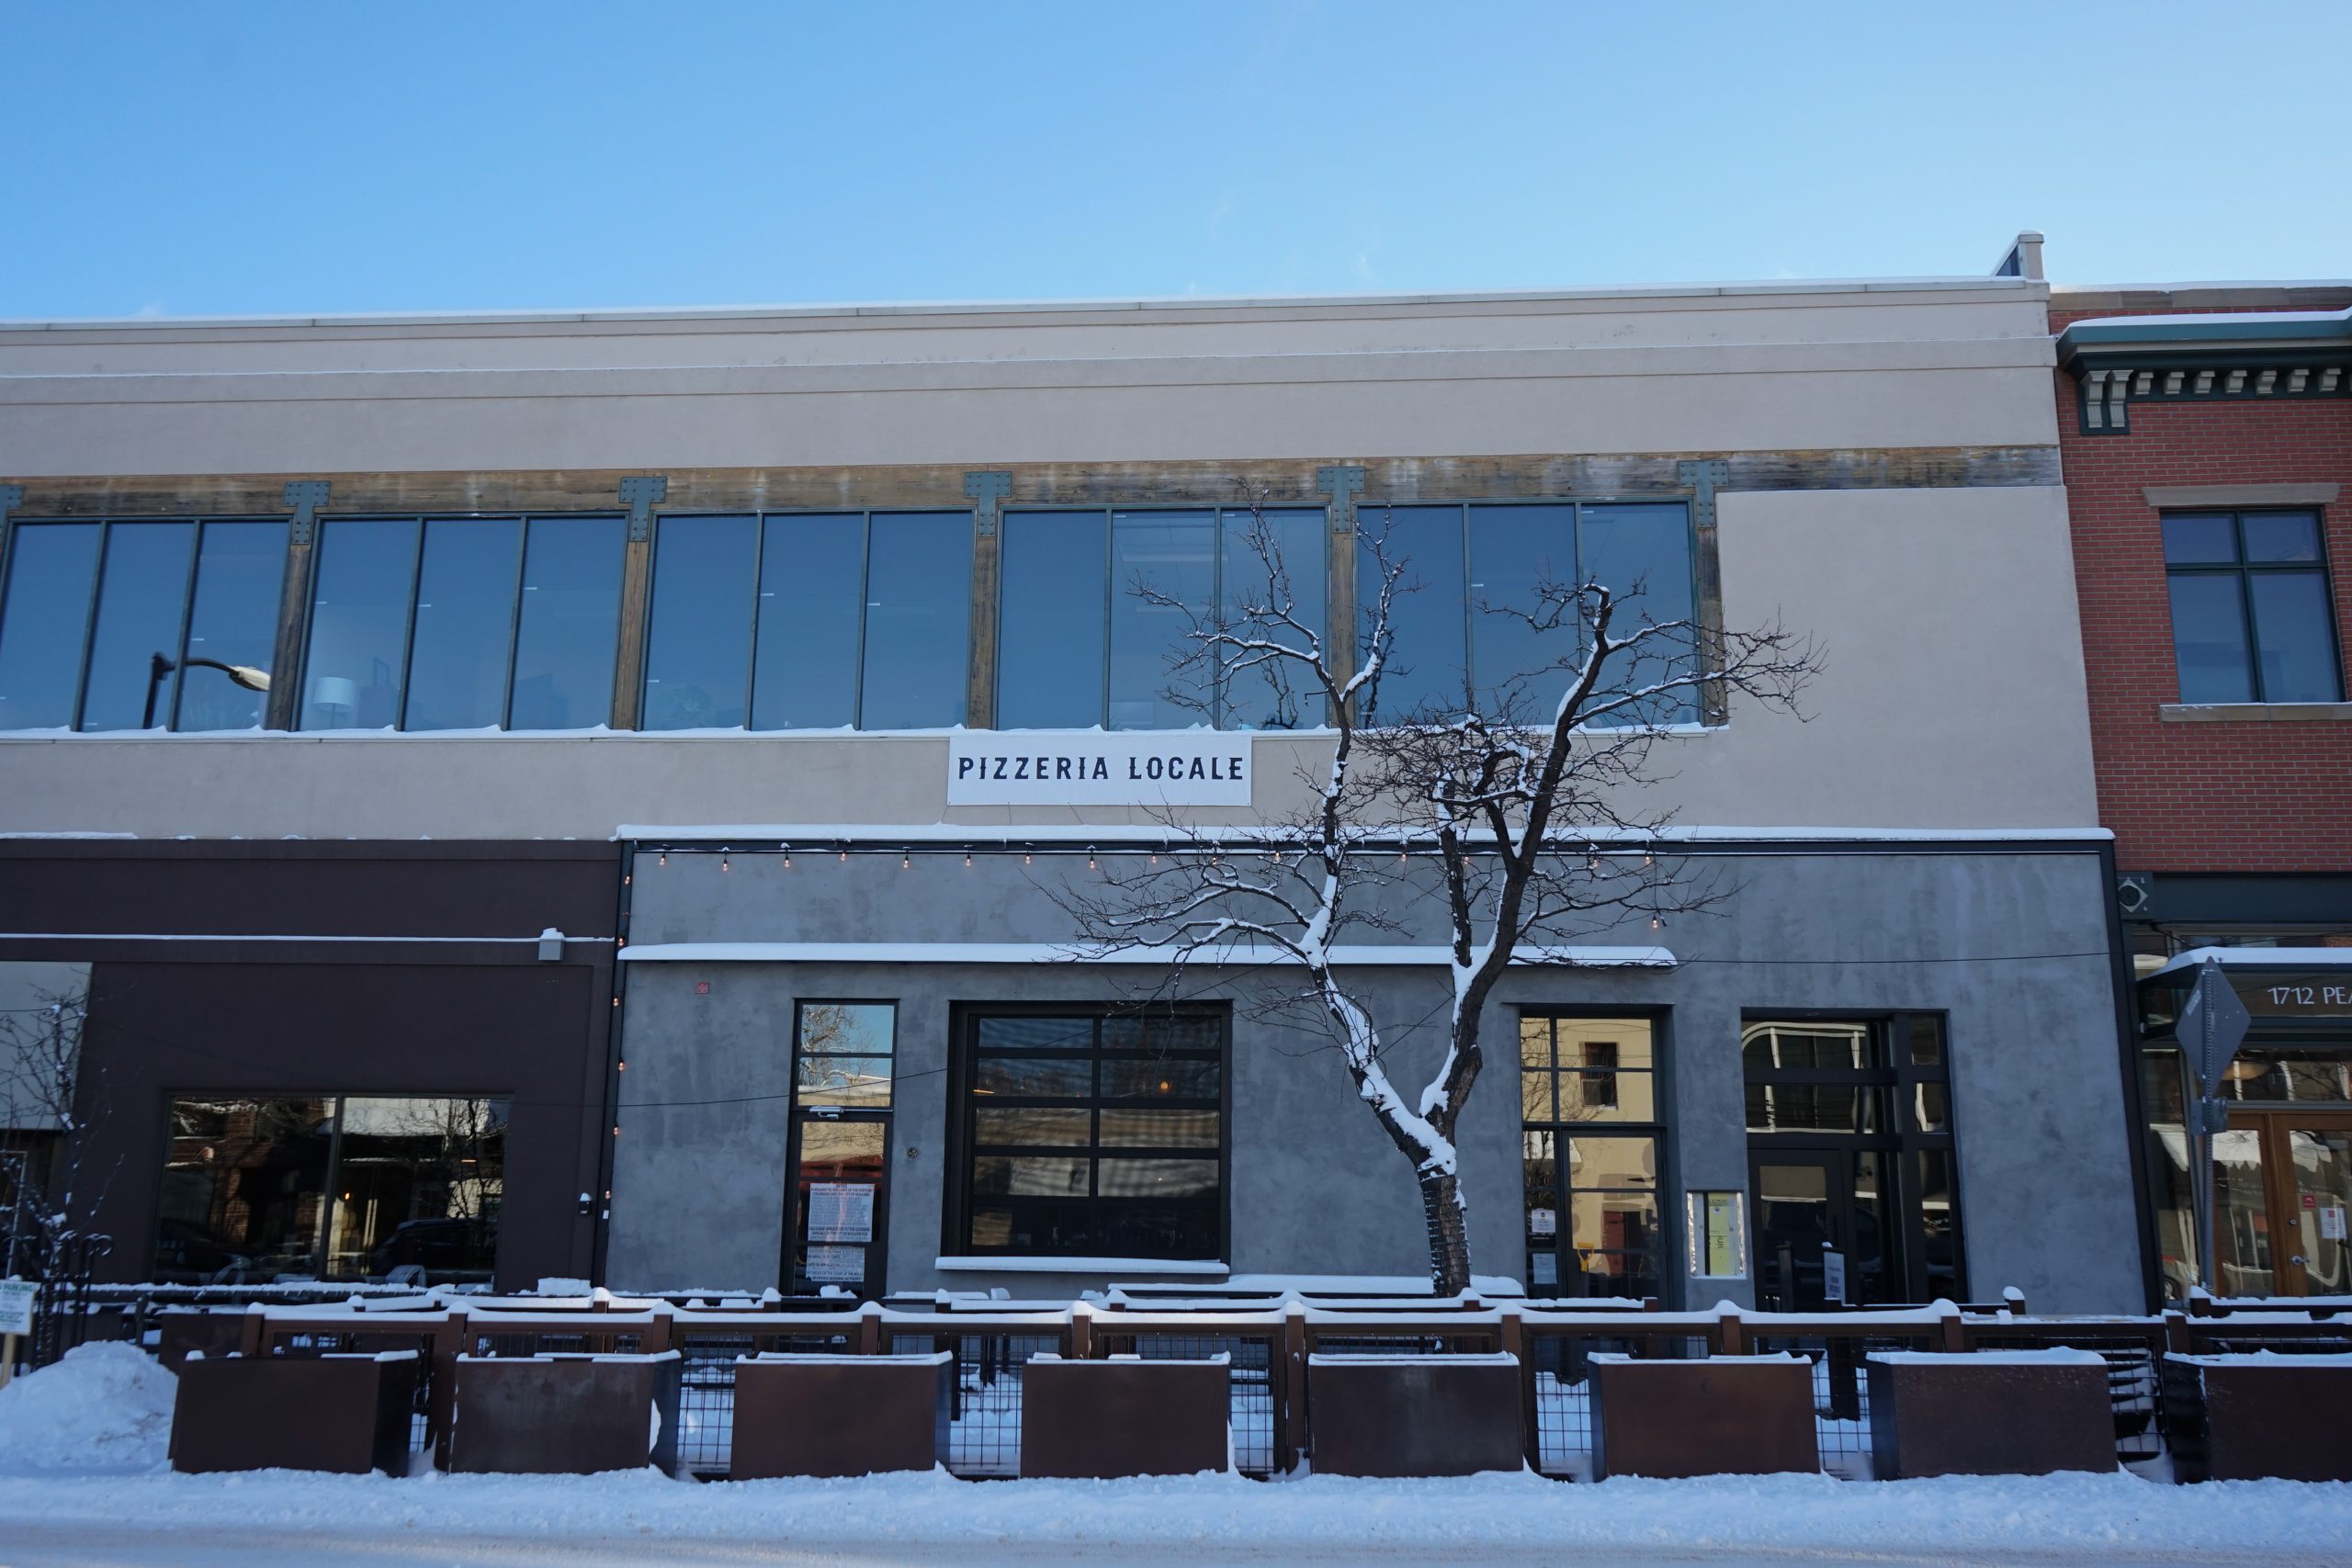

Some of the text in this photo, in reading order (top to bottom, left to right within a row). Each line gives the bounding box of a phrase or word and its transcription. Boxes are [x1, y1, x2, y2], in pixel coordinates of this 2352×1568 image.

[958, 757, 1243, 780] PIZZERIA LOCALE
[2267, 987, 2314, 1005] 1712
